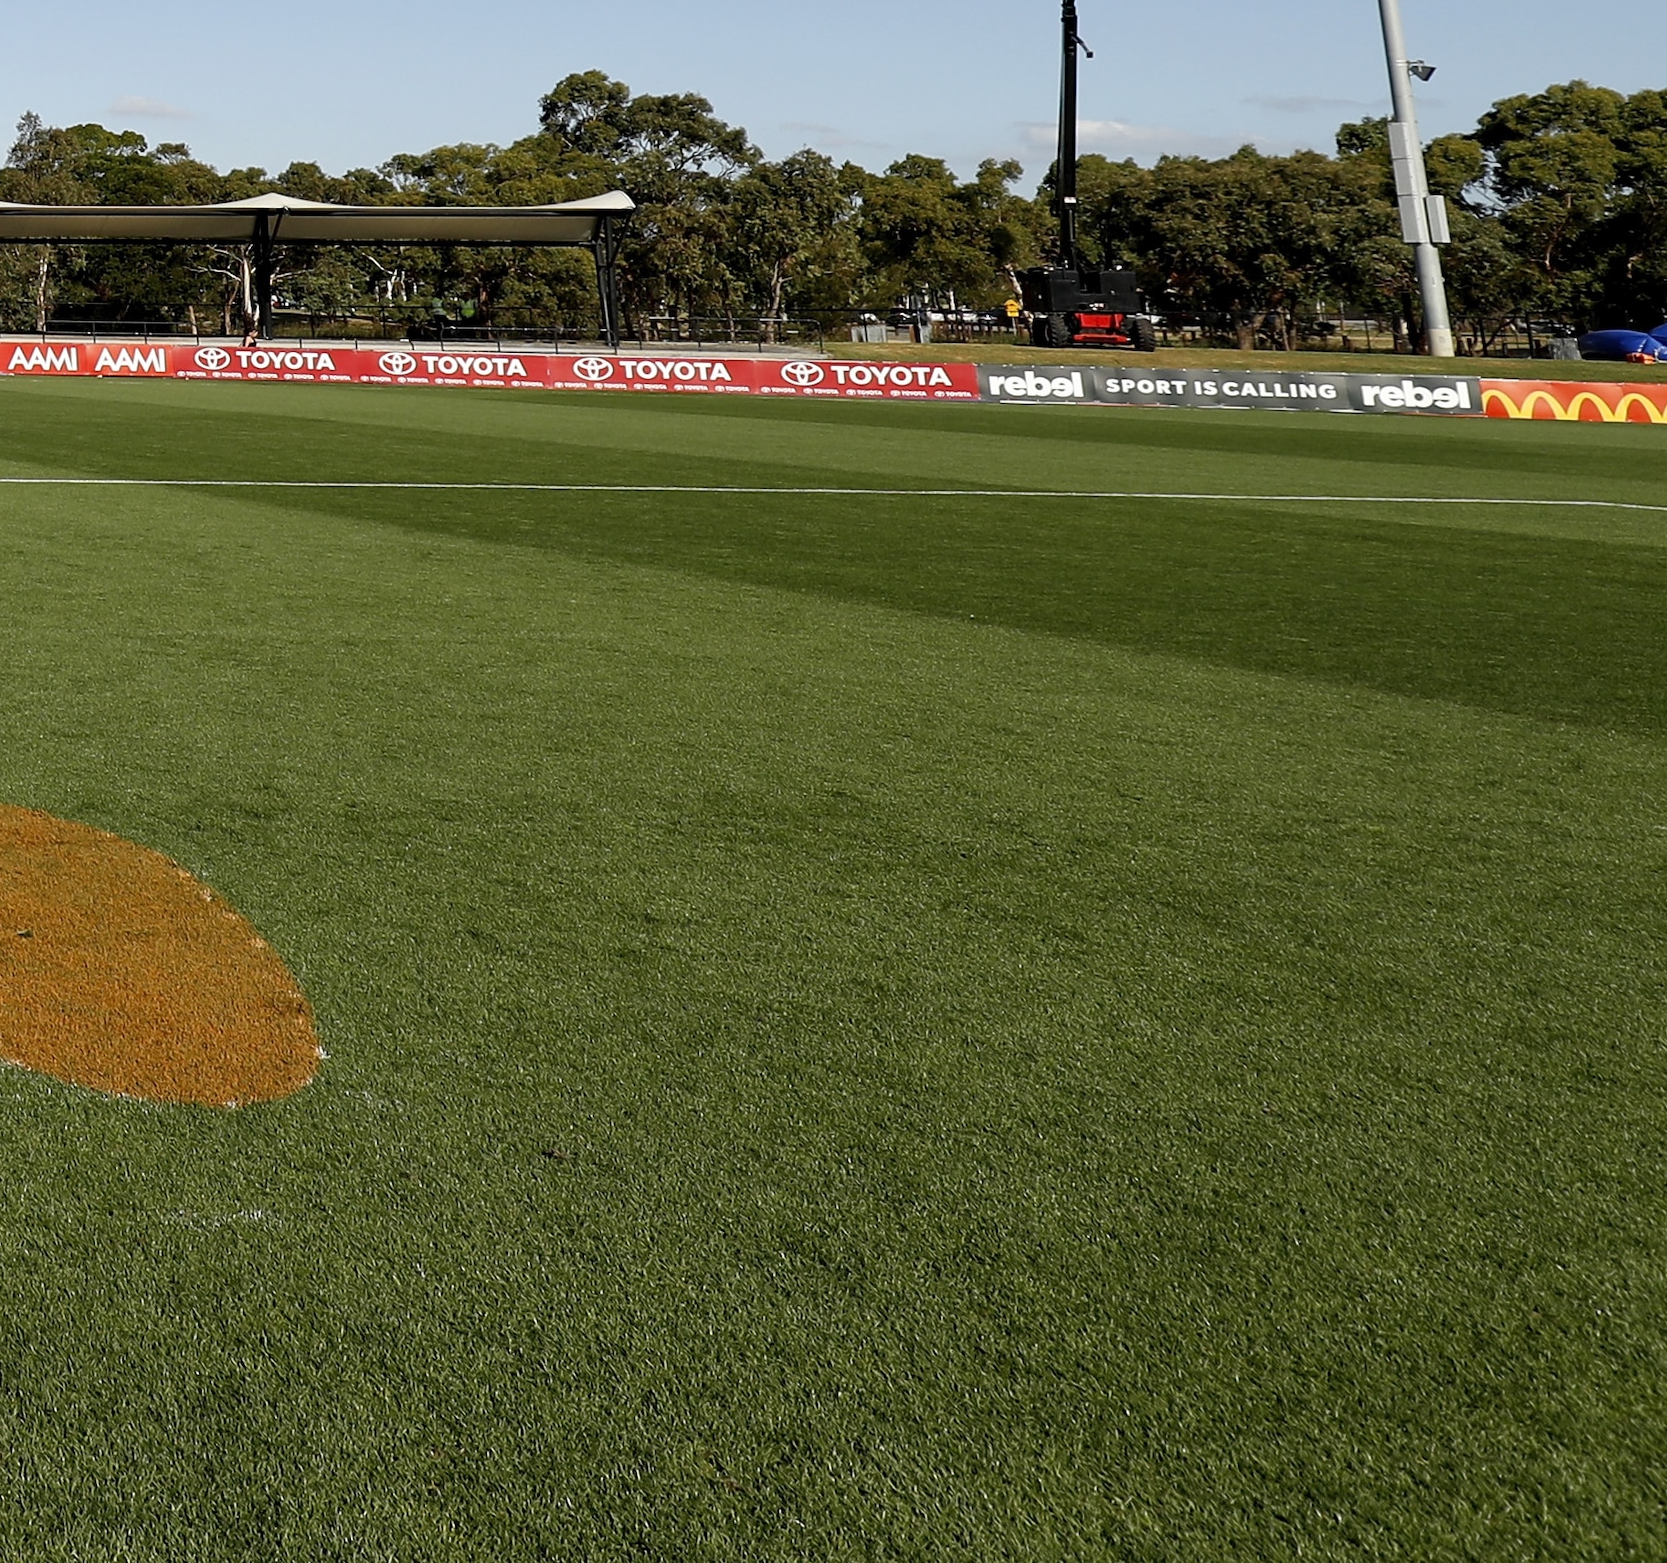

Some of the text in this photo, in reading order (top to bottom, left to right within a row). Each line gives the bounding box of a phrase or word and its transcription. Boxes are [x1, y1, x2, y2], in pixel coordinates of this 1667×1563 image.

[8, 346, 78, 371] AAMI
[94, 348, 165, 373] AAMI
[236, 350, 335, 371] TOYOTA
[422, 355, 528, 376] TOYOTA
[619, 360, 732, 381] TOYOTA
[830, 365, 952, 386] TOYOTA
[989, 371, 1084, 398] rebel
[1106, 378, 1337, 399] SPORT IS CALLING
[1360, 379, 1471, 409] rebel
